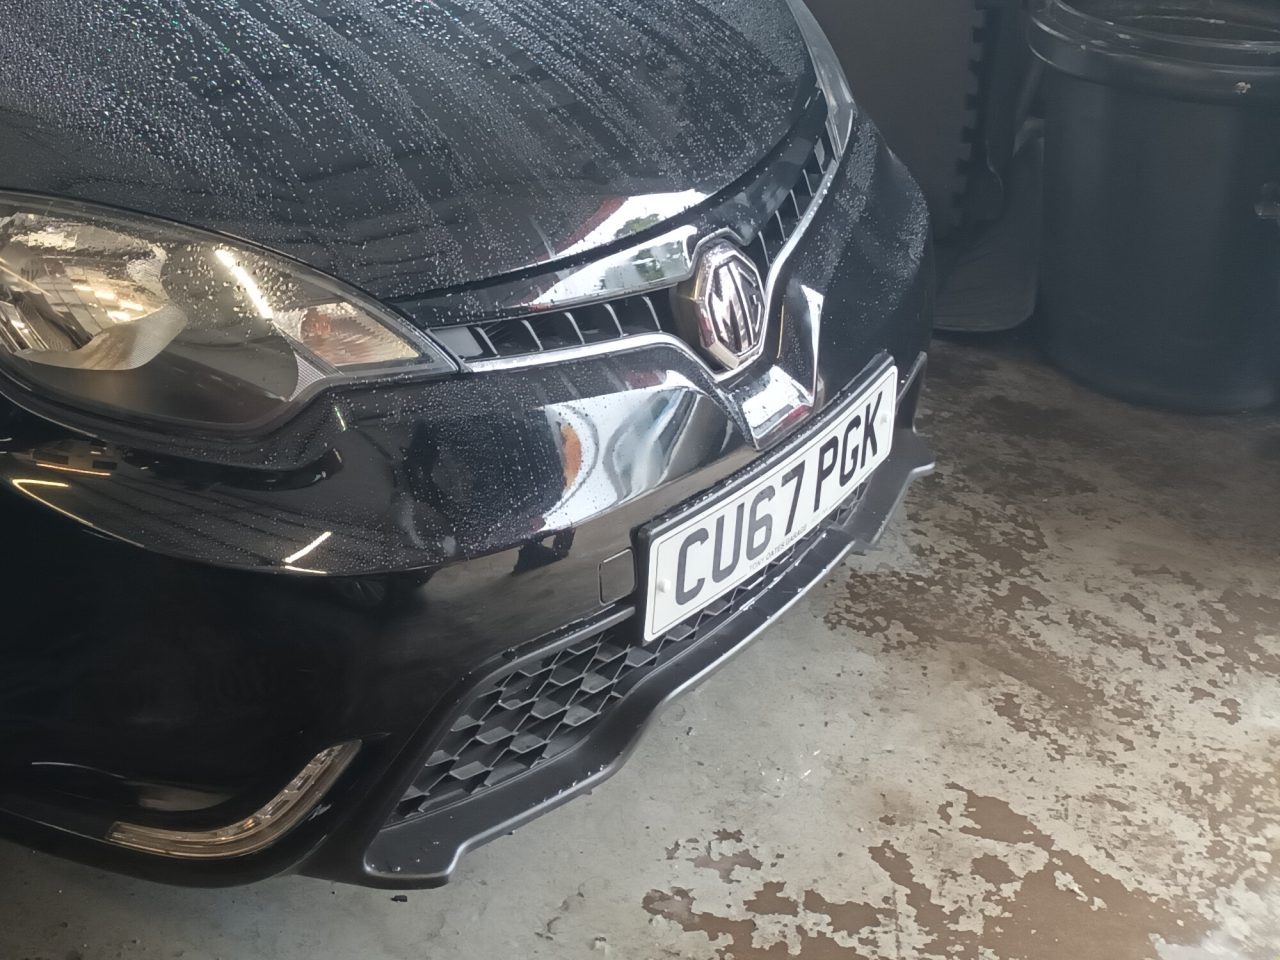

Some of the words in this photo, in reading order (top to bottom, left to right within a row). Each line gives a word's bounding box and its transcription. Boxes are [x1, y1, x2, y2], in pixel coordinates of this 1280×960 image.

[709, 260, 762, 353] MG
[675, 460, 806, 606] CU67
[813, 391, 883, 513] PGK
